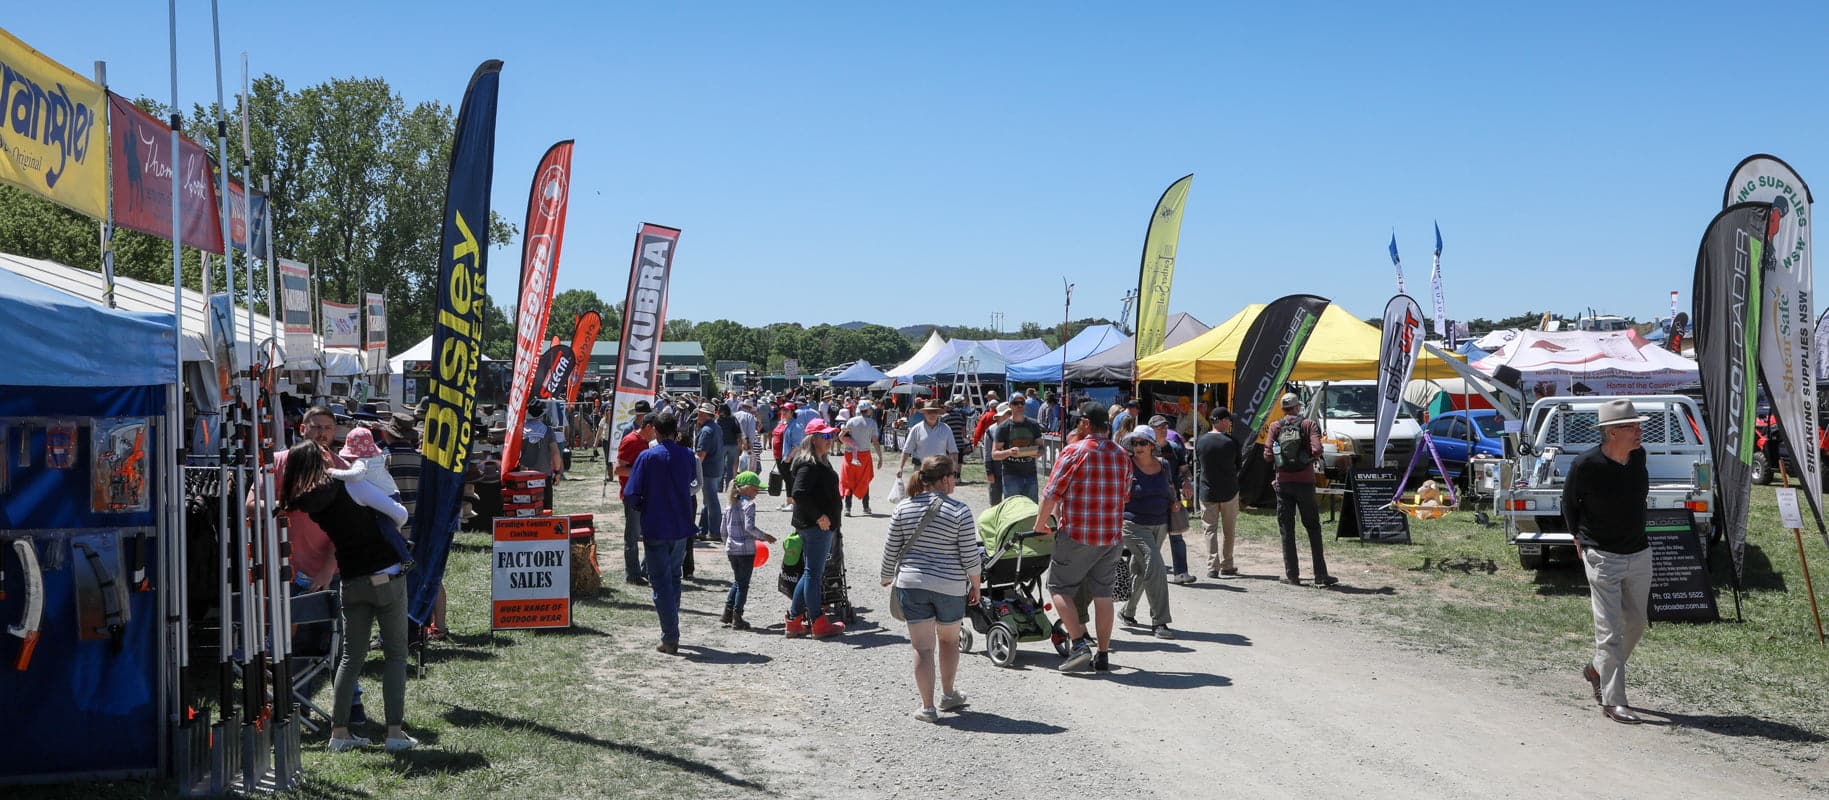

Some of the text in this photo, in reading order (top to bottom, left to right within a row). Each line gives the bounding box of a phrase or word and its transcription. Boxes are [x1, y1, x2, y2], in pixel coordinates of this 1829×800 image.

[0, 61, 95, 189] rangler
[12, 146, 43, 171] Original
[1758, 175, 1808, 228] SUPPLIES
[1783, 236, 1806, 269] NSW
[422, 209, 480, 470] Bisley
[453, 272, 485, 473] WORKWEAR
[626, 241, 669, 389] AKUBRA
[1242, 306, 1306, 426] LYCOLOADER
[1726, 227, 1749, 458] LYCOLOADER
[1799, 291, 1816, 474] SHEARING SUPPLIES NSW
[497, 550, 565, 568] FACTORY
[510, 571, 553, 589] SALES
[500, 615, 537, 624] OUTDOOR
